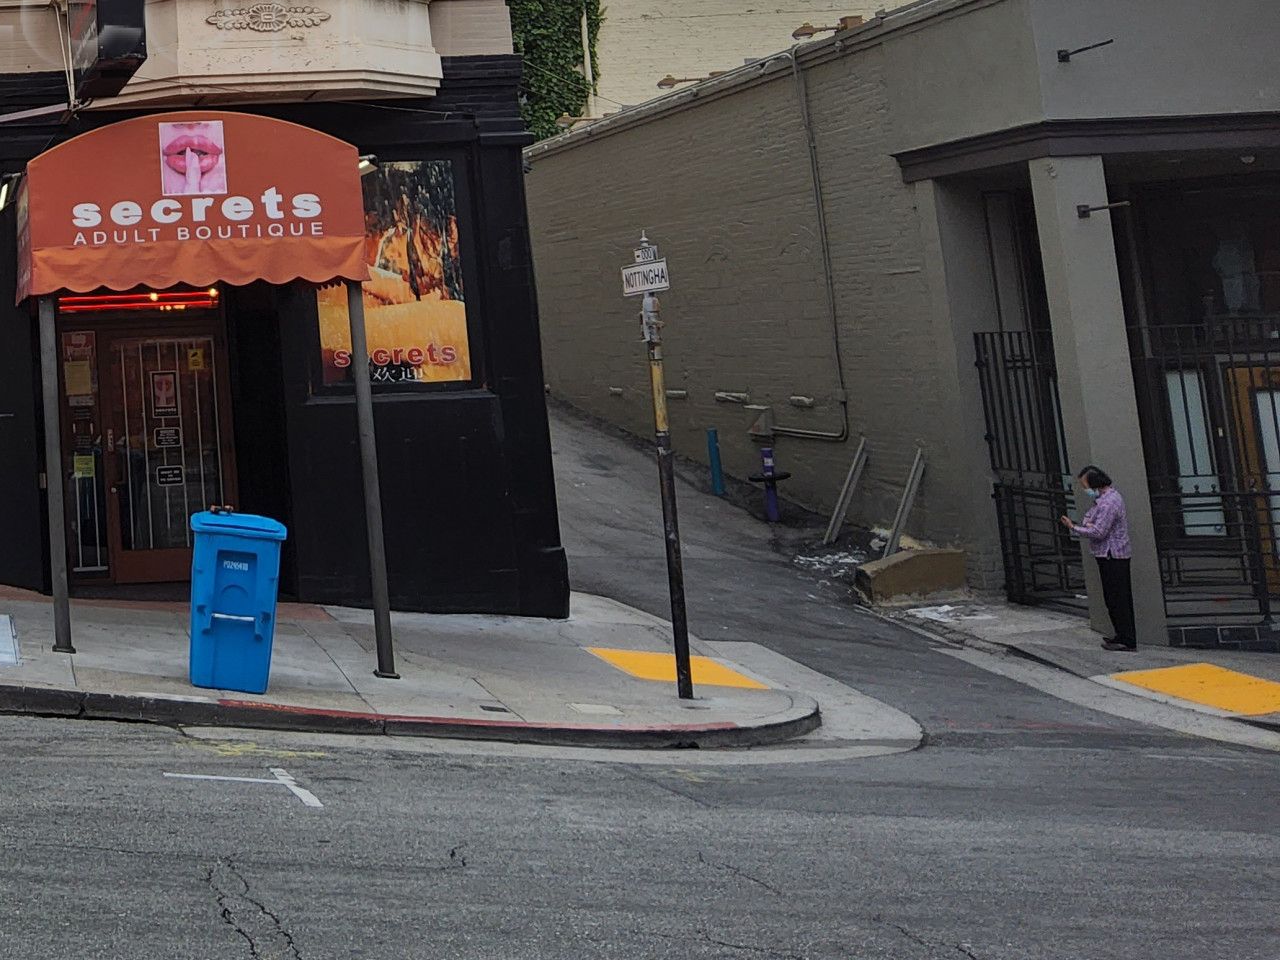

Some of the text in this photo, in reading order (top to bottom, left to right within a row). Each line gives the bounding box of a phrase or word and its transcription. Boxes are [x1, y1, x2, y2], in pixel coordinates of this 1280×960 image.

[72, 186, 322, 228] secrets
[73, 222, 324, 246] ADULT BOUTIQUE
[624, 268, 667, 289] NOTTINGHA
[333, 341, 457, 368] screts
